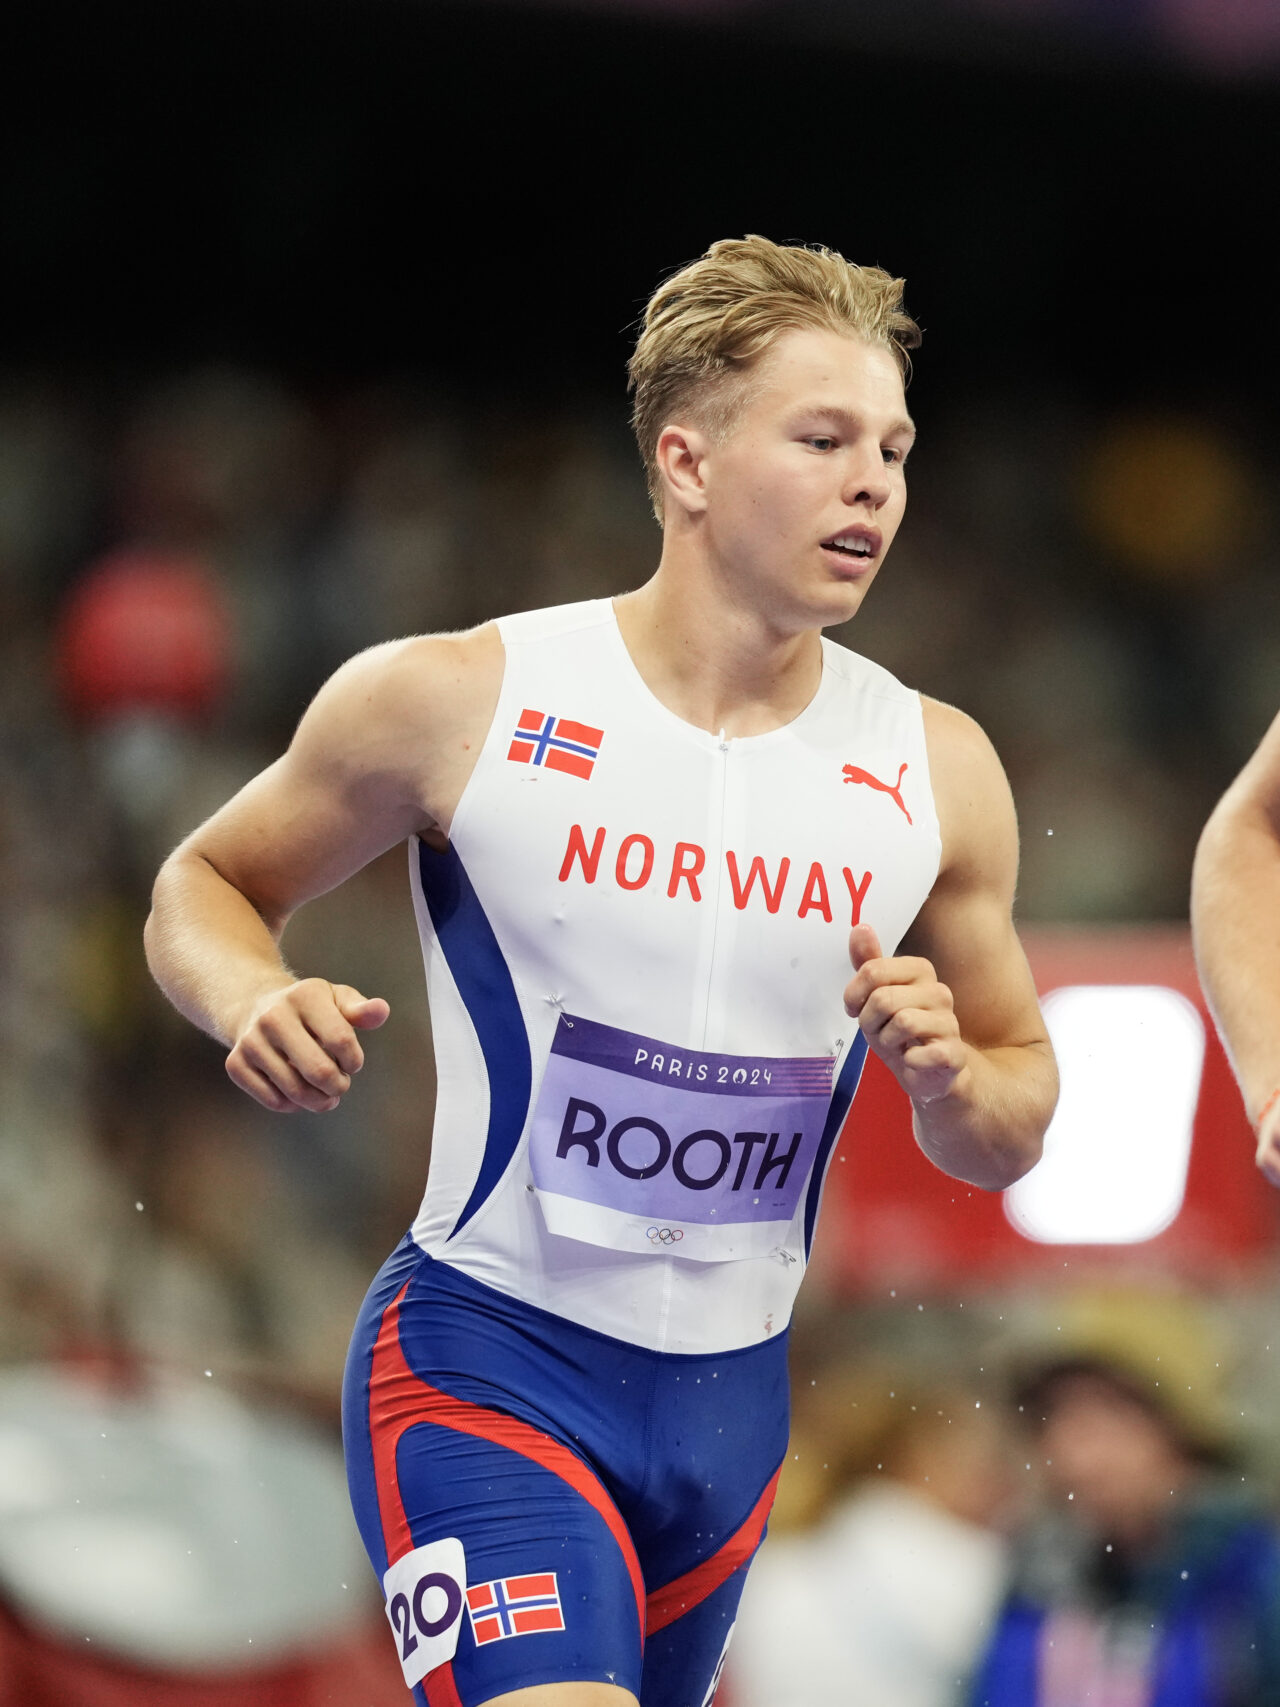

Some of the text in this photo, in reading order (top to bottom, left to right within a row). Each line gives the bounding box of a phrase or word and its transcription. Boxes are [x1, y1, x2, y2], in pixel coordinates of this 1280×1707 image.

[558, 824, 872, 927] NORWAY
[634, 1048, 772, 1085] PARIS 2024
[556, 1096, 802, 1192] ROOTH
[390, 1572, 462, 1662] 20
